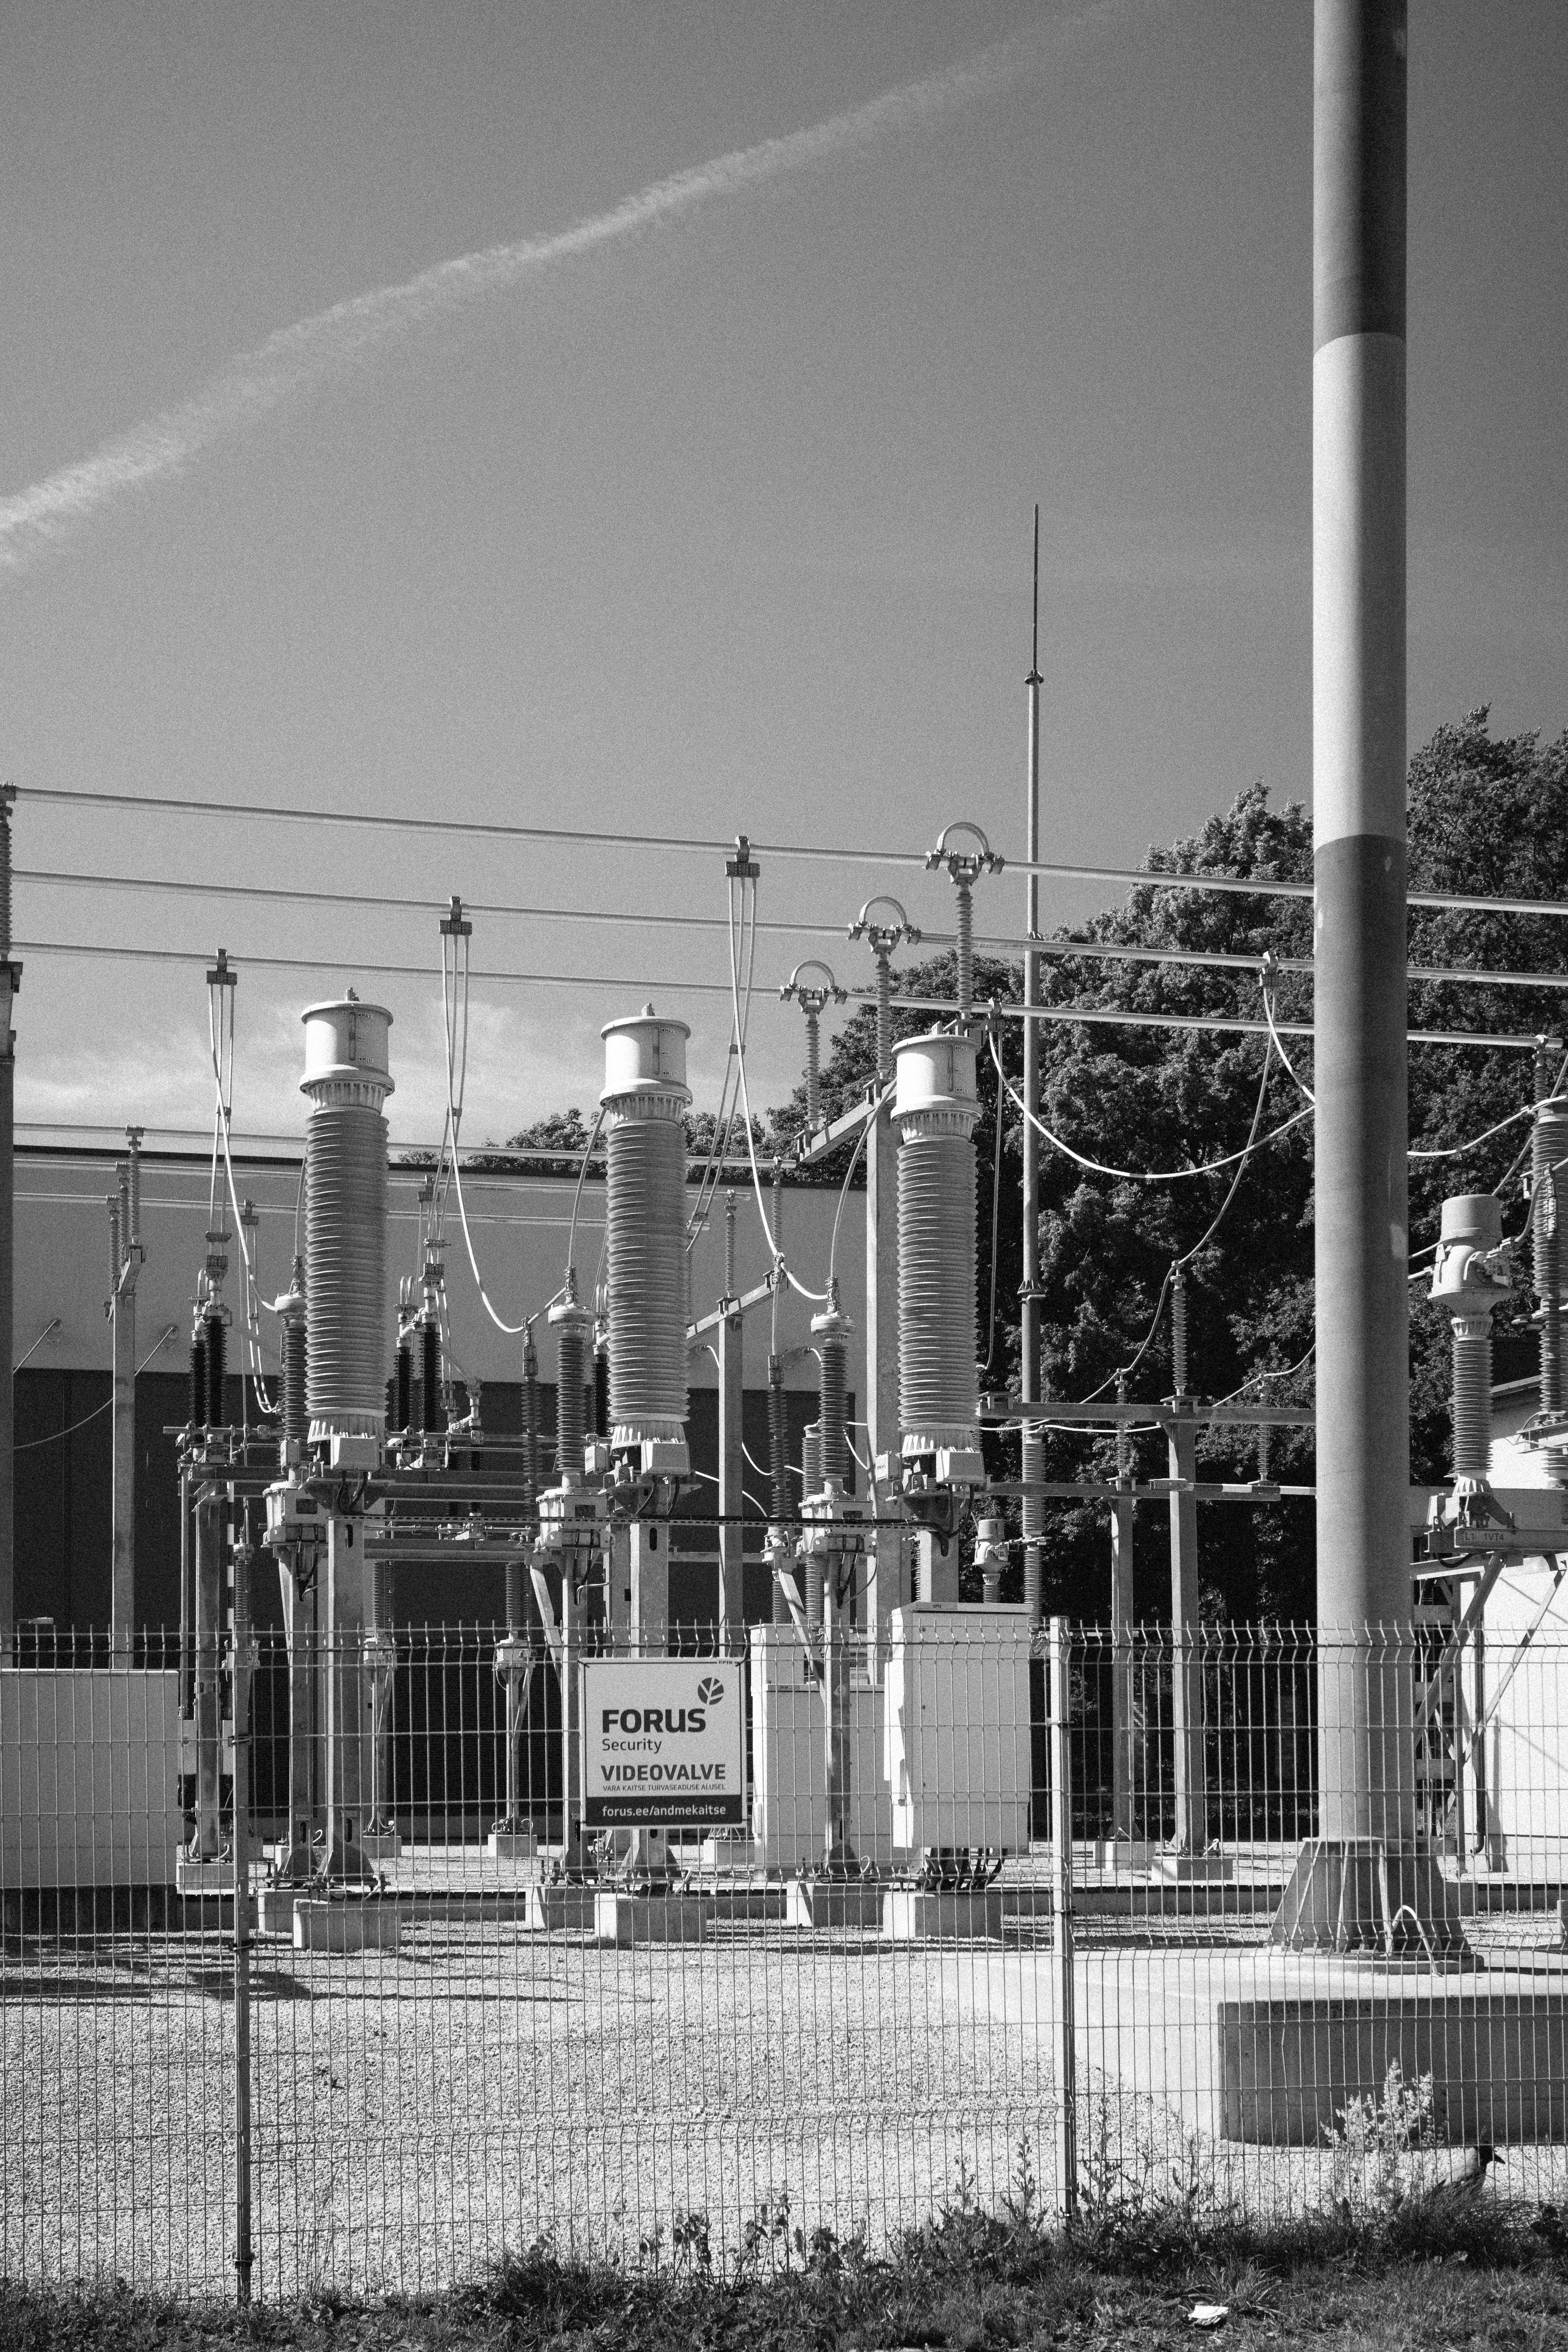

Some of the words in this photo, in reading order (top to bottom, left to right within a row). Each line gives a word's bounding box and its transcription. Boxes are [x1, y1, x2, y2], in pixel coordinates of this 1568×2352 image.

[1484, 1533, 1504, 1541] 1VT4
[602, 1708, 706, 1733] FORUS
[602, 1738, 662, 1753] Security
[601, 1764, 726, 1781] VIDEOVALVE
[602, 1804, 726, 1817] forus.ee/andmekaitse
